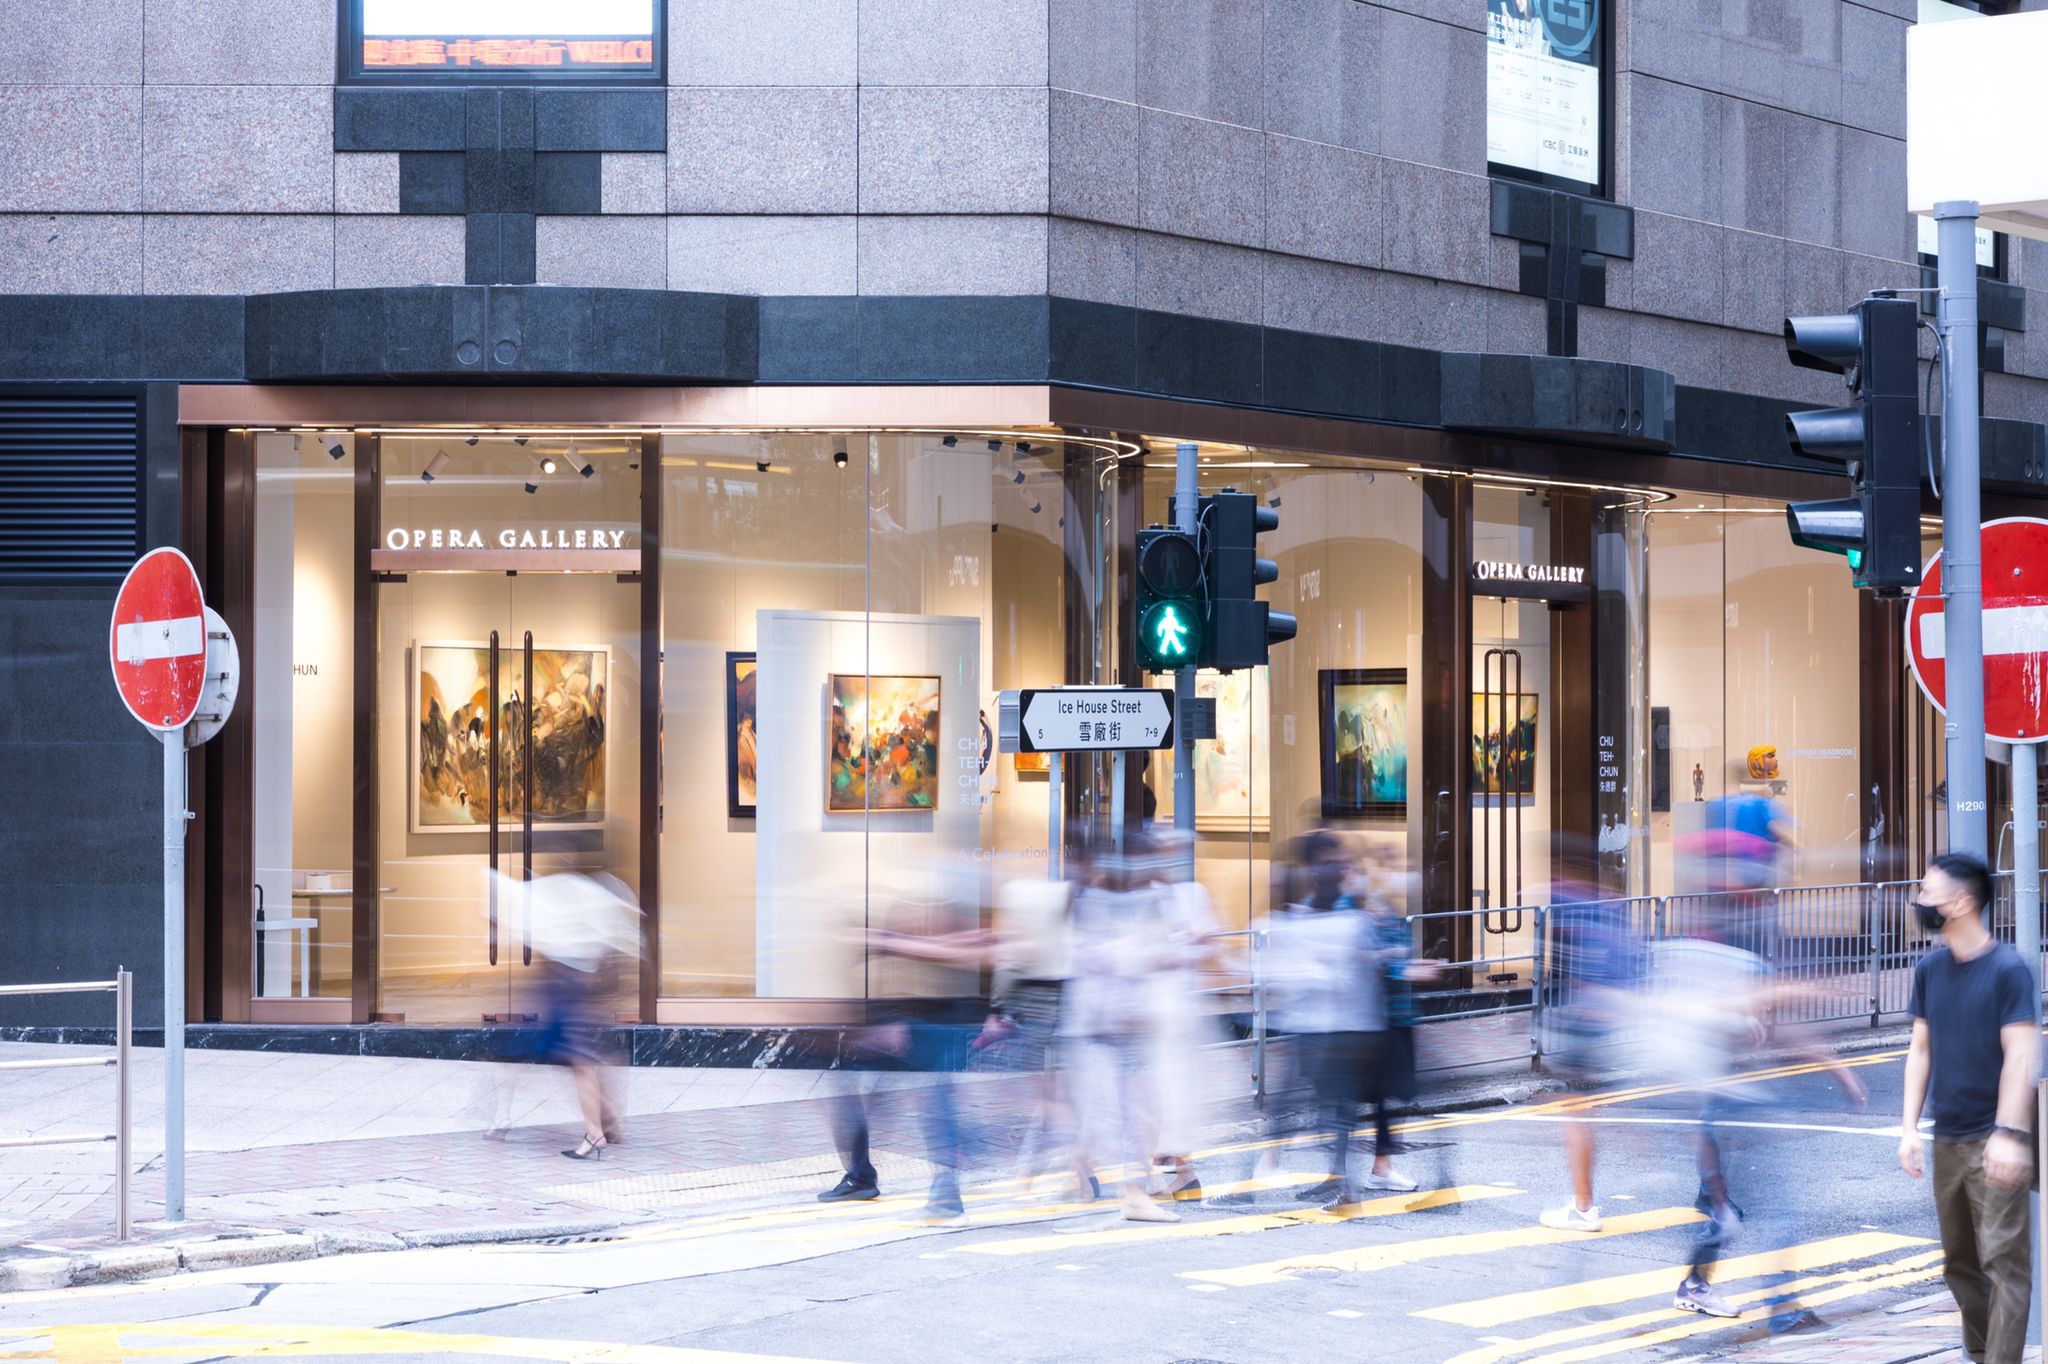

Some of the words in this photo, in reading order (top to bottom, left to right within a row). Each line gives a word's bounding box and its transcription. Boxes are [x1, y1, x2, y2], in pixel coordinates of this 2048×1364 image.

[387, 528, 483, 550] OPERA
[499, 529, 625, 549] GALLERY
[1478, 560, 1523, 580] OPERA
[1528, 564, 1584, 583] GALLERY
[1058, 700, 1073, 714] Ice
[1076, 700, 1107, 714] House
[1111, 700, 1141, 714] Street
[1038, 728, 1044, 740] 5
[1079, 721, 1121, 742] 雪廠街
[958, 738, 988, 750] CHU
[1599, 736, 1614, 746] CHU
[958, 756, 989, 769] TEH-
[1600, 751, 1614, 762] TEH-
[1599, 766, 1619, 777] CHUN
[1956, 800, 1985, 812] H290
